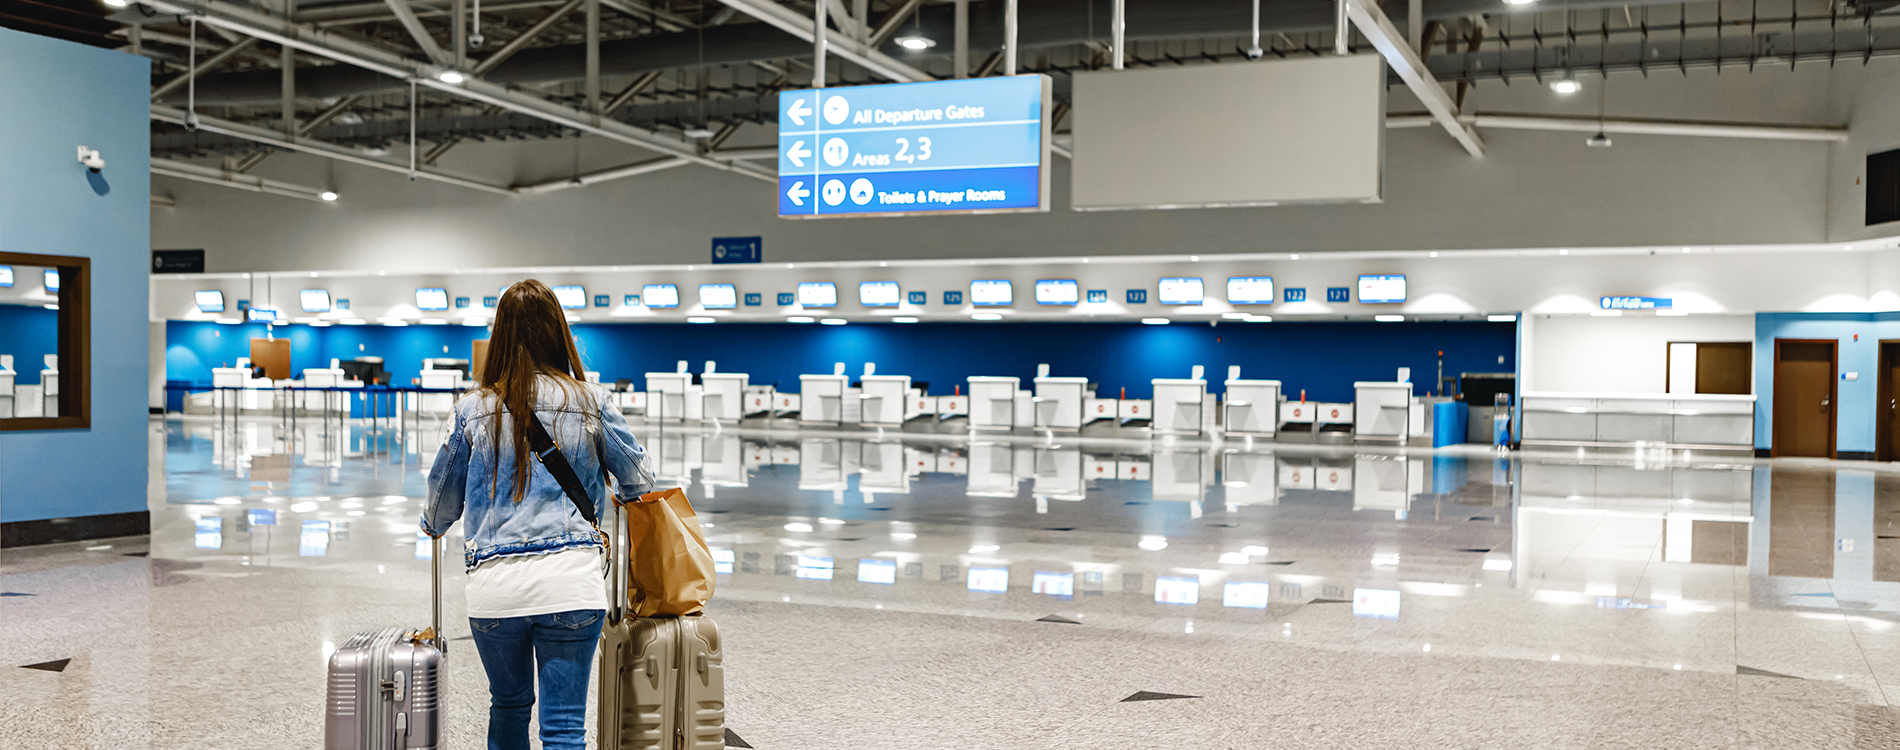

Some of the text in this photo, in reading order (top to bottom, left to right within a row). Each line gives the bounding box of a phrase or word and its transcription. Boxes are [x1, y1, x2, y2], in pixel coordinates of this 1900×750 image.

[853, 105, 985, 125] All Departure Gates
[852, 153, 890, 166] Areas
[878, 188, 1006, 205] Toilets & Prayer Rooms
[750, 242, 755, 259] 1
[1330, 290, 1347, 300] 121
